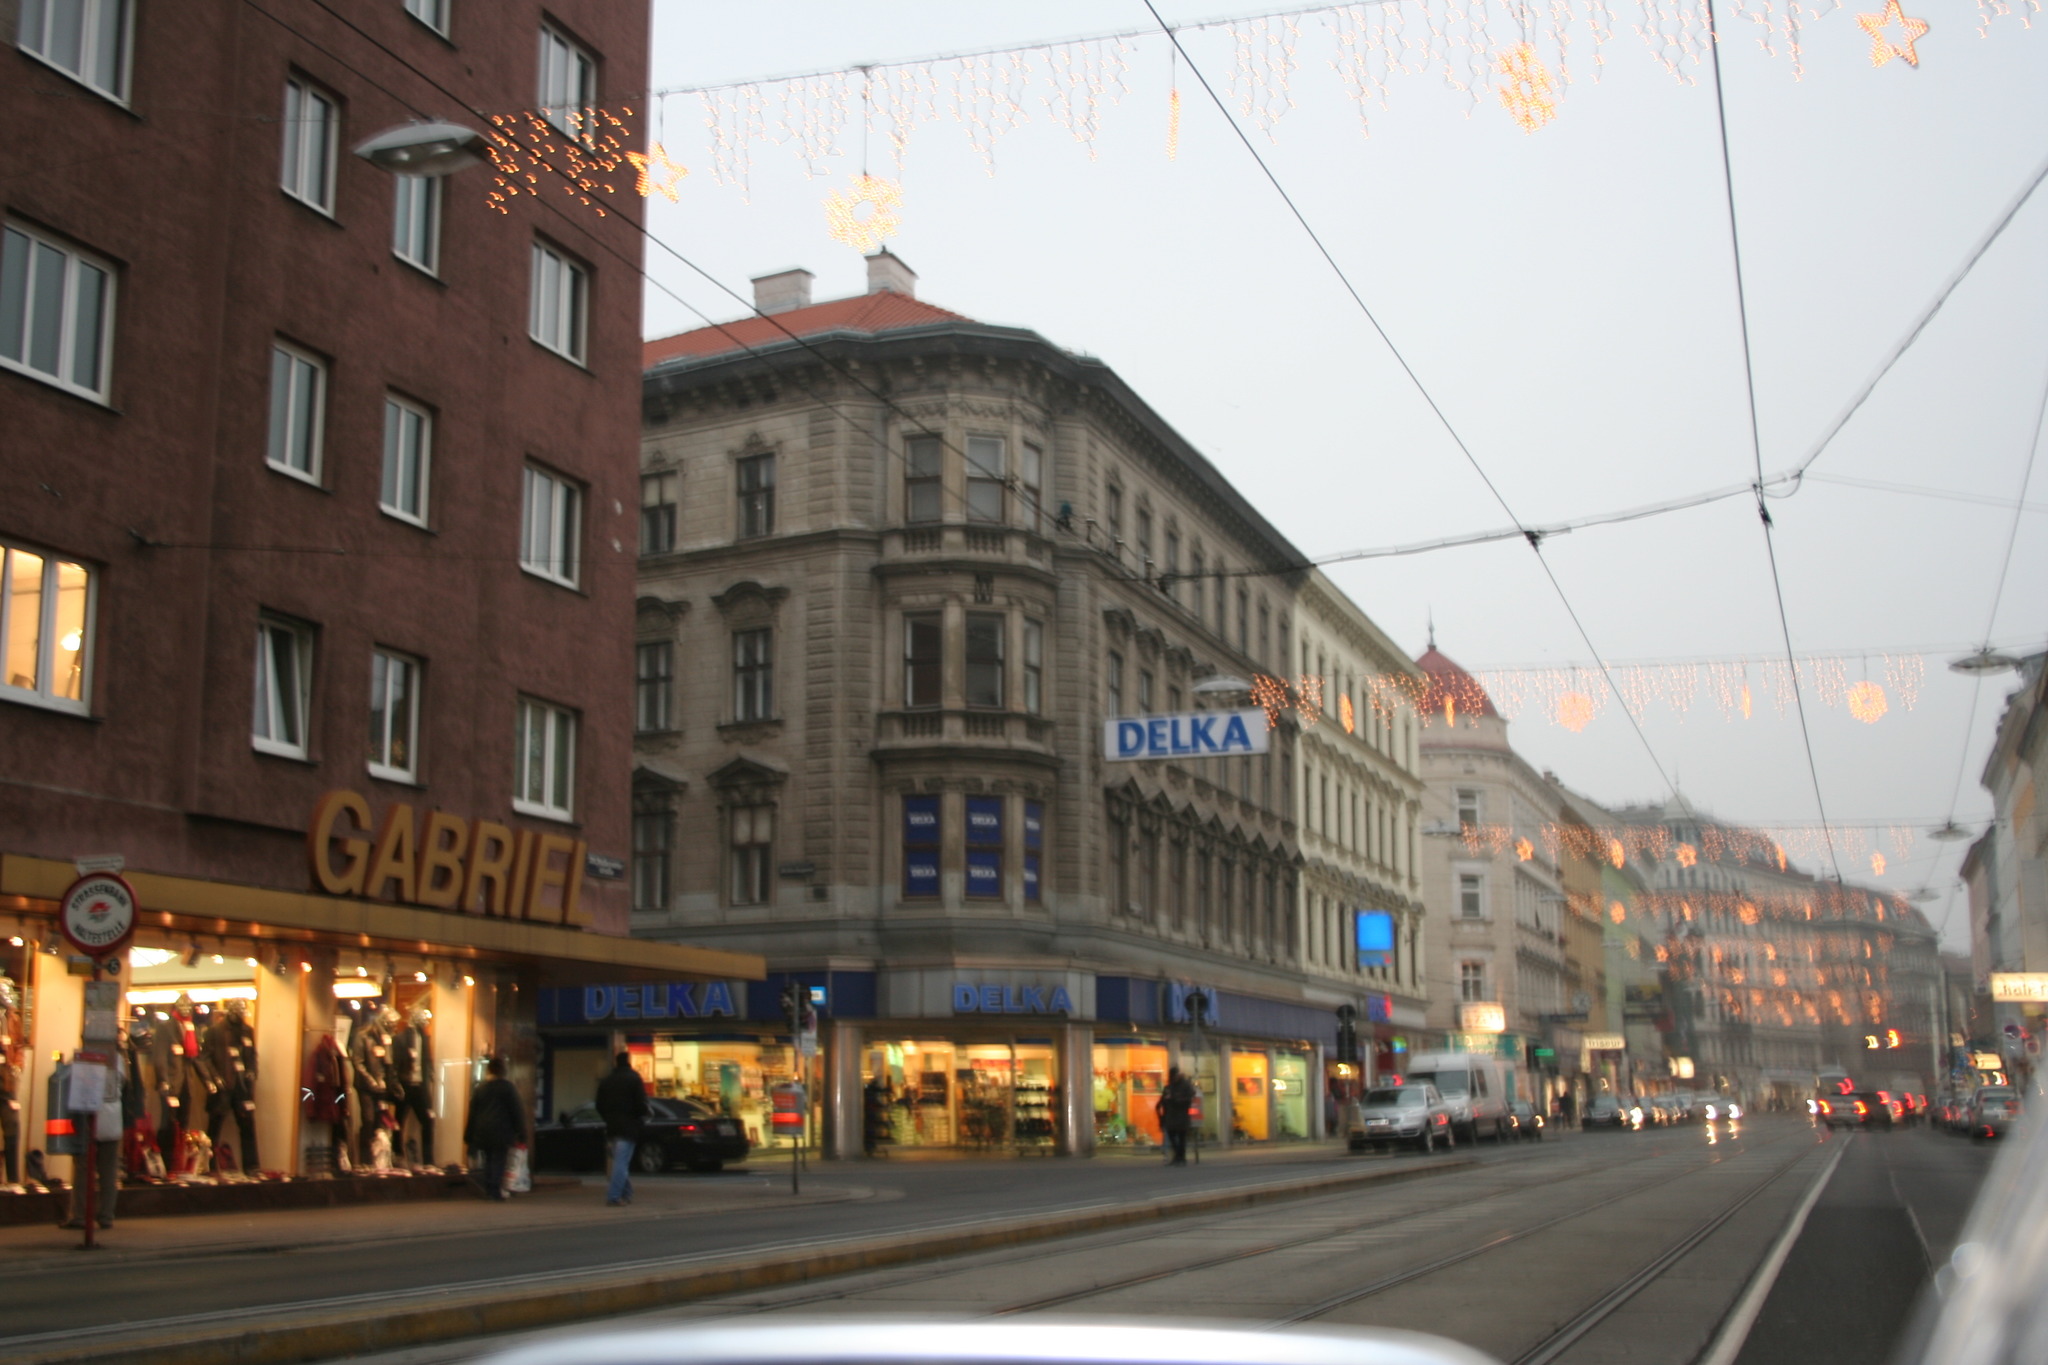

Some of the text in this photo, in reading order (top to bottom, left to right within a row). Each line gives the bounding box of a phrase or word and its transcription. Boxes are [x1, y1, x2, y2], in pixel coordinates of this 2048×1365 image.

[1118, 714, 1253, 757] DELKA
[909, 813, 936, 824] DELKA
[970, 813, 998, 825] DELKA
[302, 789, 594, 926] GABRIEL
[910, 866, 937, 877] DELKA
[970, 866, 997, 878] DELKA
[584, 982, 735, 1020] DELKA
[953, 984, 1074, 1014] DELKA
